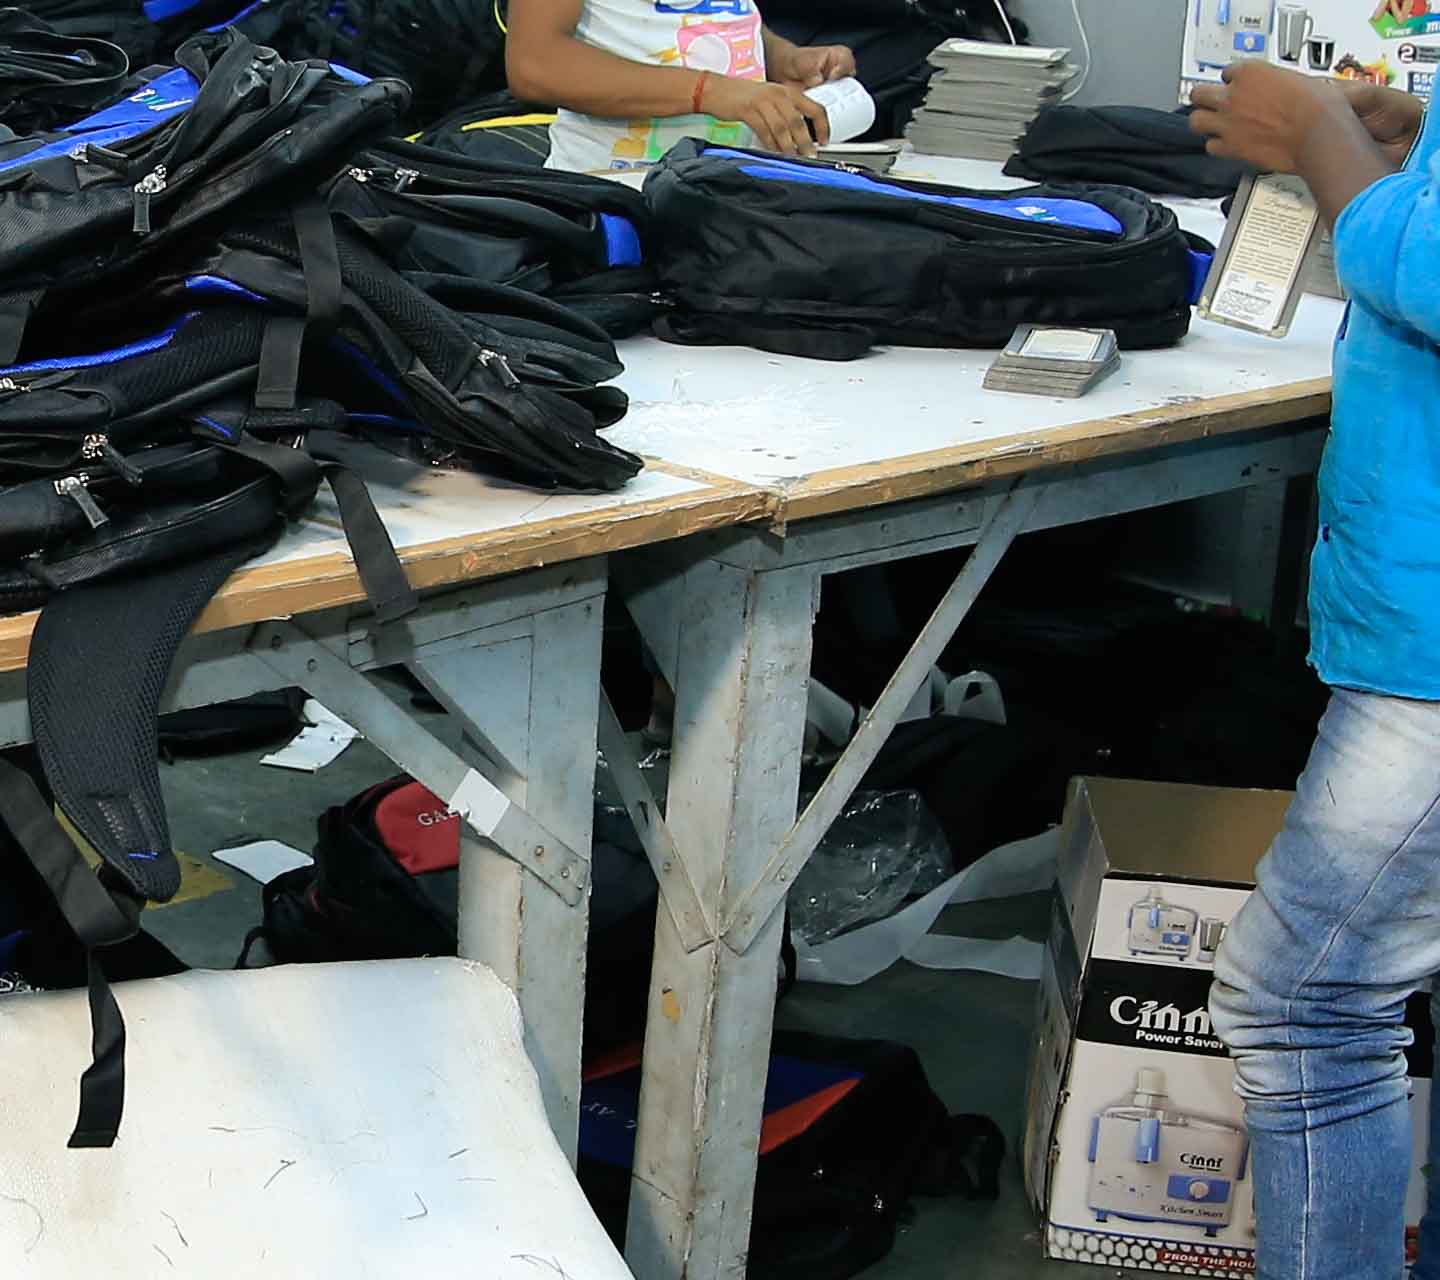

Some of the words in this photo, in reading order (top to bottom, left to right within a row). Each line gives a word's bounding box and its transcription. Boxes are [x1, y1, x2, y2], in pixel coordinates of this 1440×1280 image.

[1109, 995, 1217, 1037] Cinn
[1135, 1029, 1182, 1045] Power
[1180, 1152, 1224, 1169] Cinni
[1164, 1253, 1199, 1264] FROM
[1202, 1257, 1227, 1267] THE
[1229, 1259, 1256, 1270] HOU
